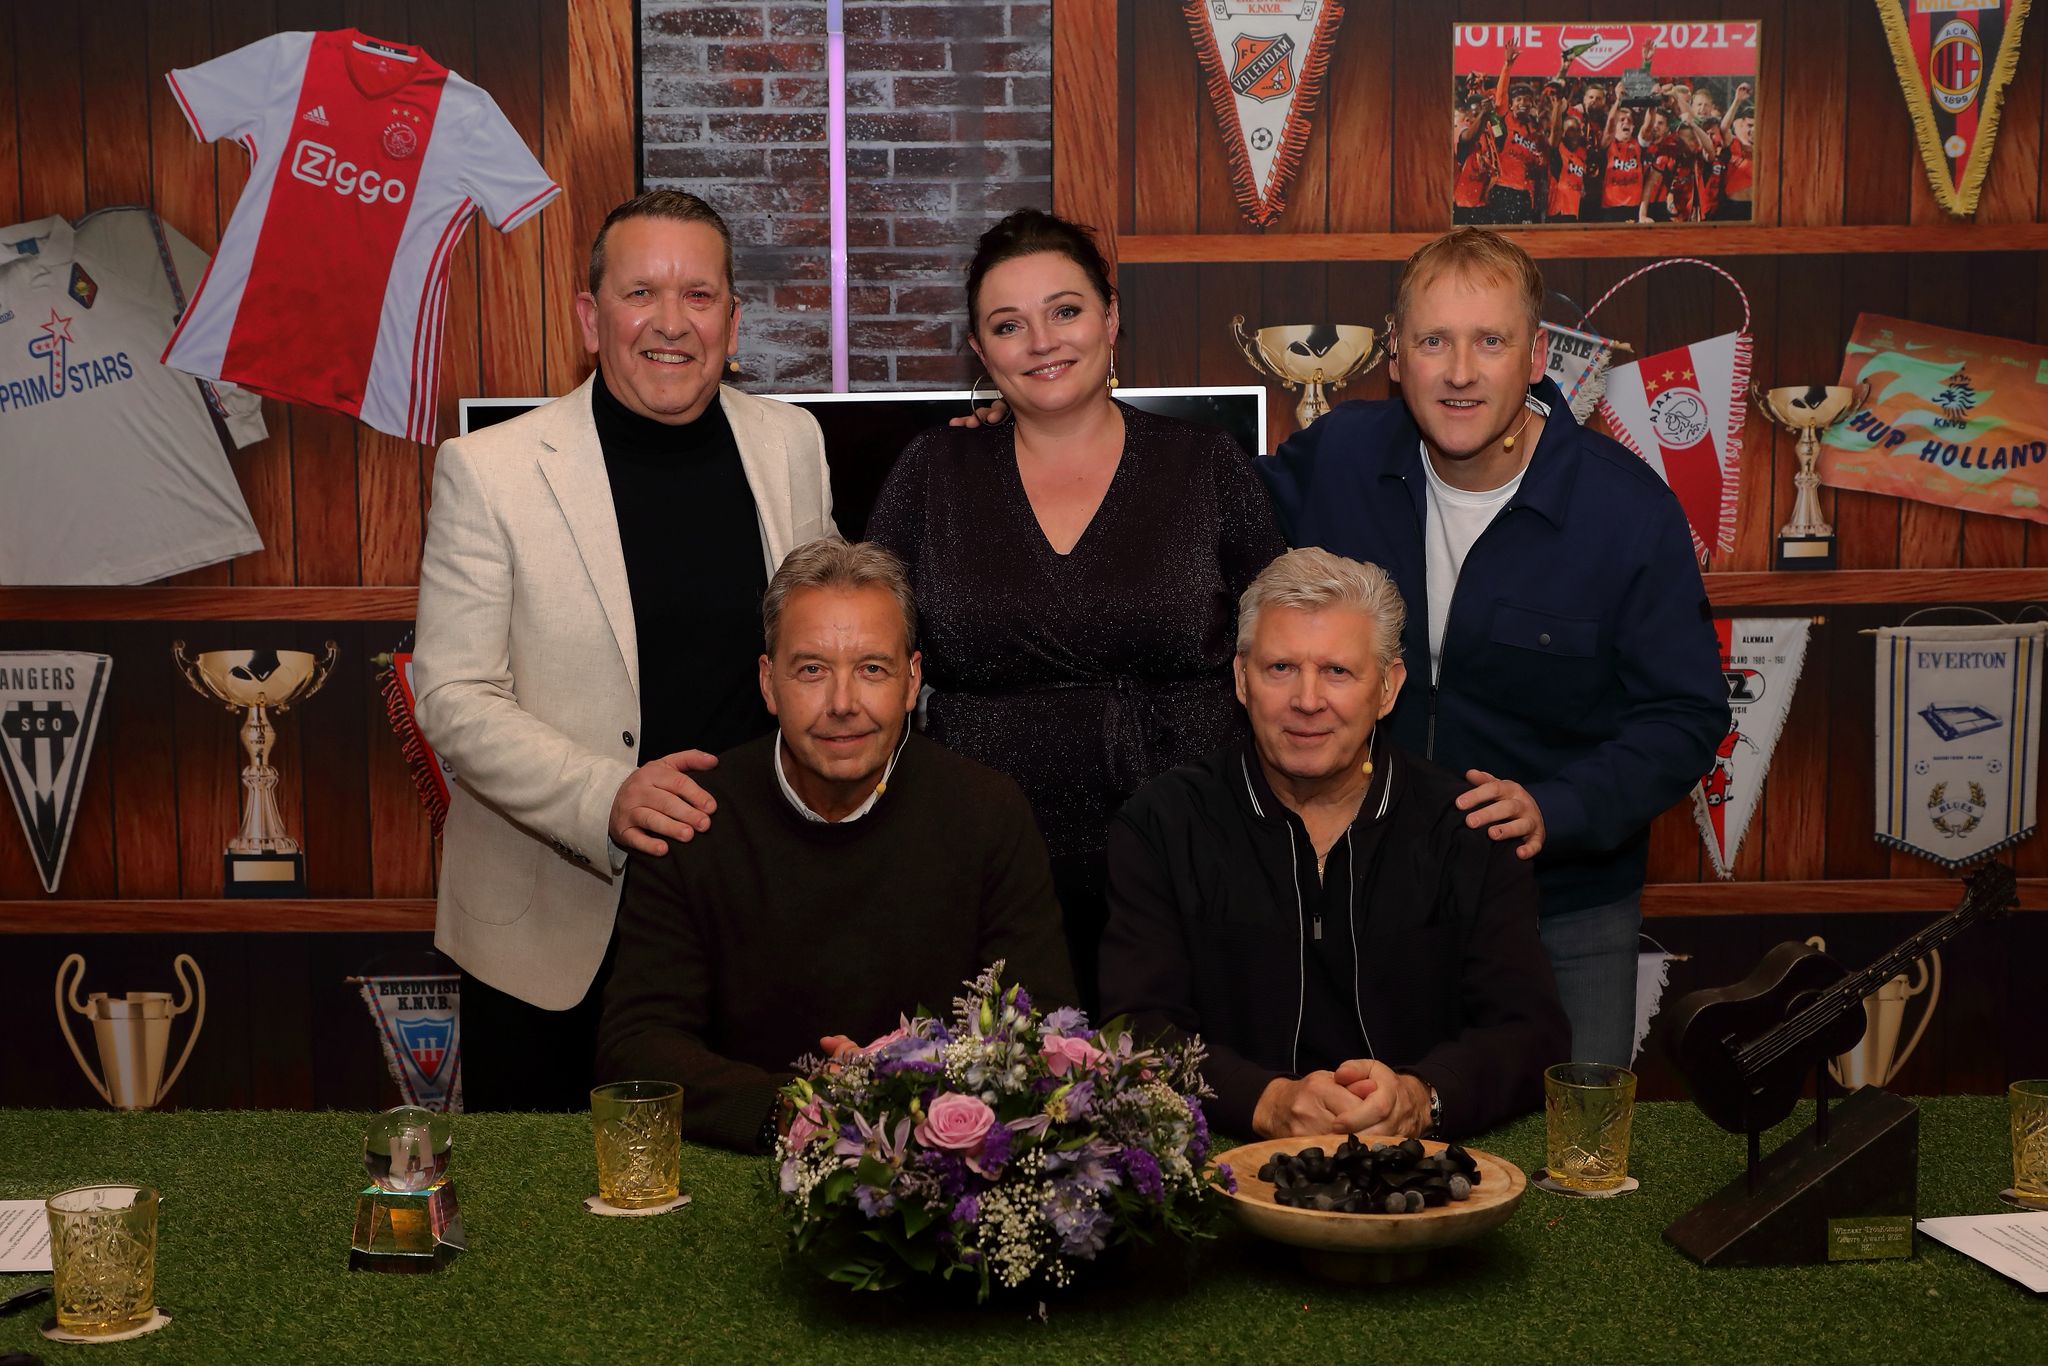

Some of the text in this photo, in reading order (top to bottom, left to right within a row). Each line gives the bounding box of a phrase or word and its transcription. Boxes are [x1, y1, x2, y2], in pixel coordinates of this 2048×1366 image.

[1945, 27, 1969, 37] ACM
[1233, 38, 1291, 91] VOLENDAM
[1943, 95, 1969, 104] 1899
[68, 352, 133, 393] STARS
[1650, 392, 1672, 423] AJAX
[1934, 417, 1967, 430] KNVB
[1850, 411, 2048, 470] HUP HOLLAND
[1742, 636, 1774, 644] ALKMAAR
[1918, 652, 2006, 669] EVERTON
[0, 667, 75, 690] ANGERS
[380, 981, 460, 996] EREDIVISI
[398, 996, 452, 1010] K.N.V.B.
